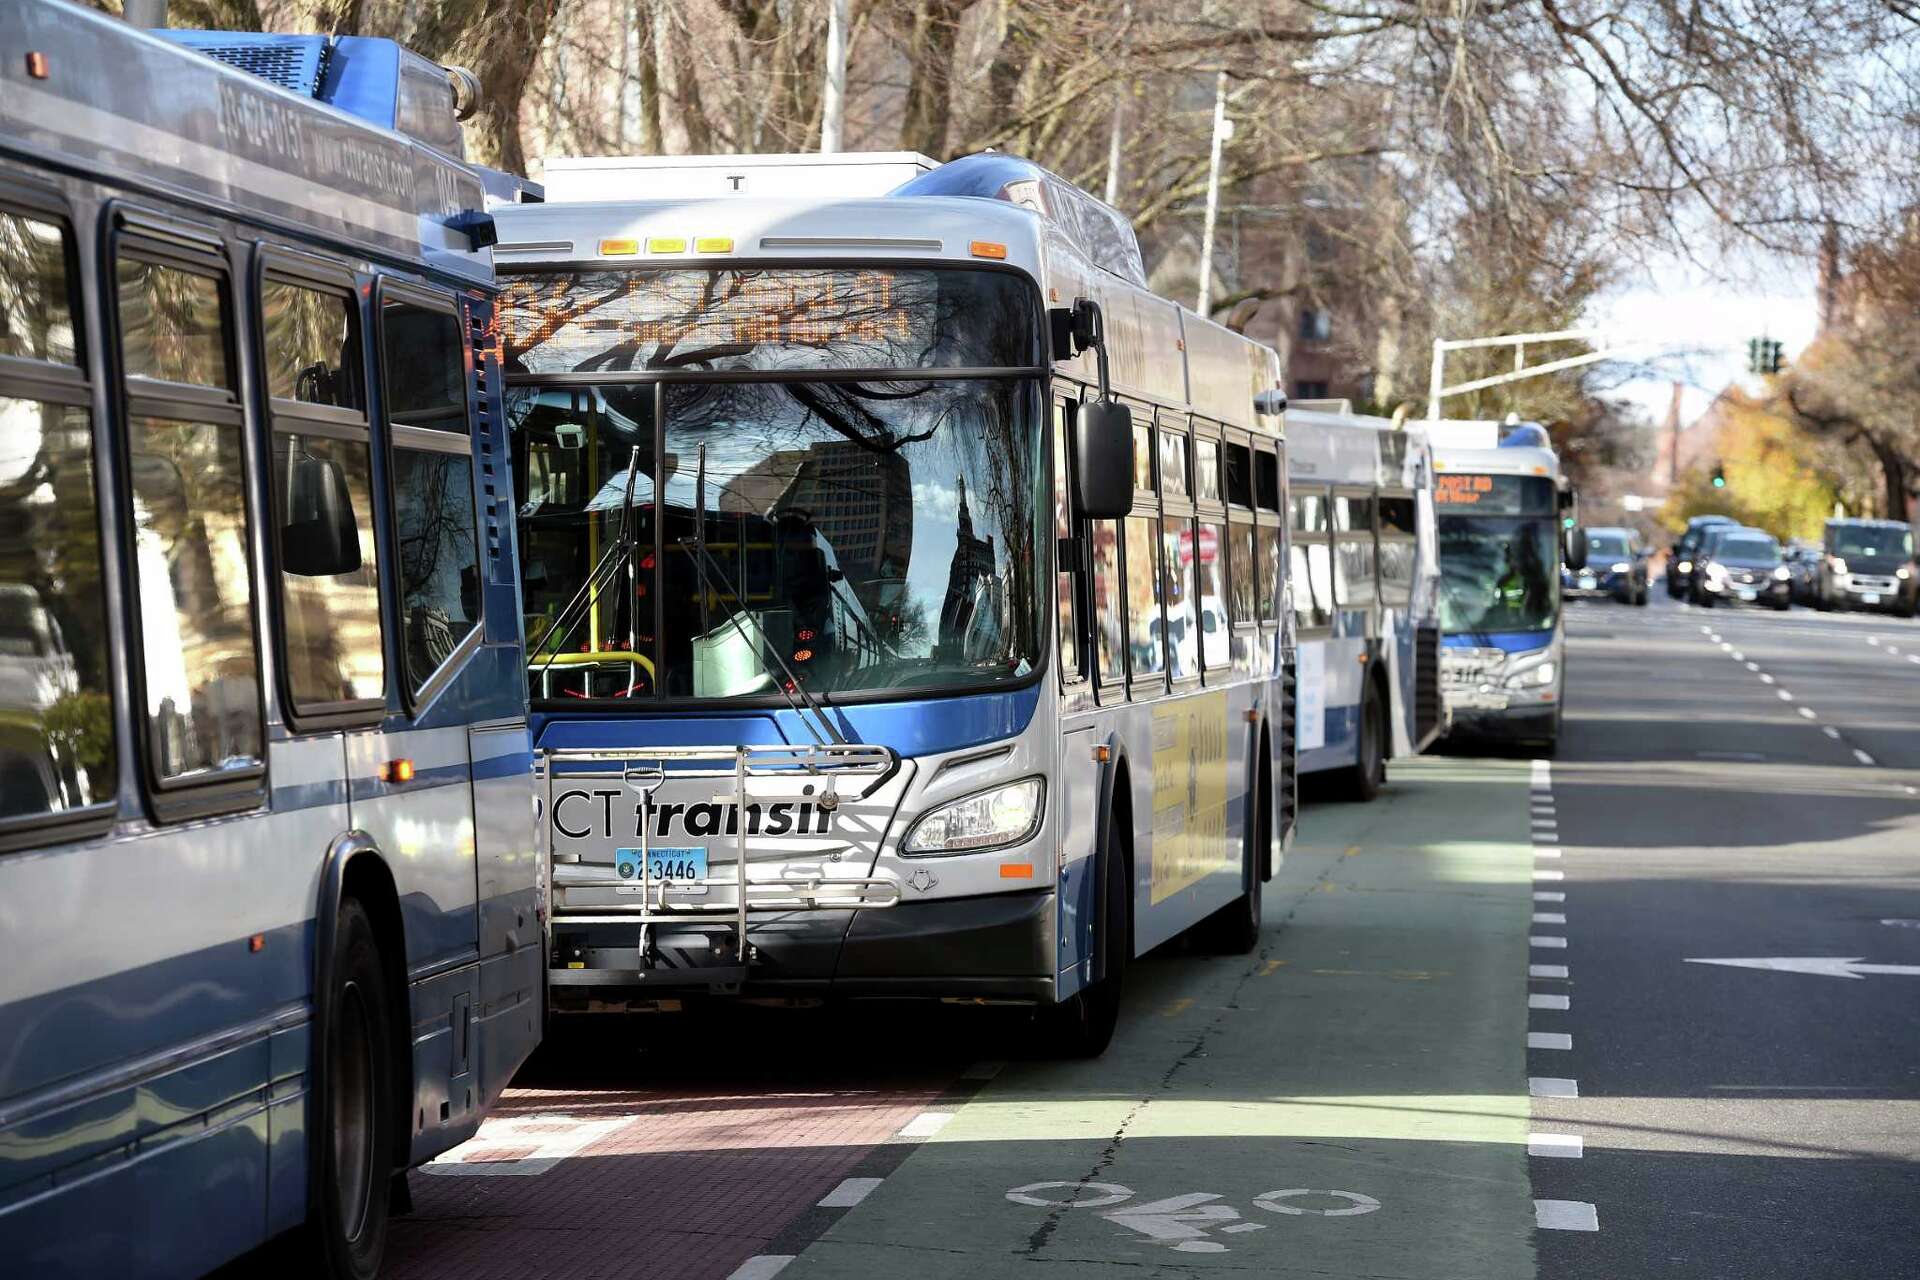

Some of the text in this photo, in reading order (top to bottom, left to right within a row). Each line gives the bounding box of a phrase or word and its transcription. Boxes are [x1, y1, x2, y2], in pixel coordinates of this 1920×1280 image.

[552, 784, 838, 838] CT transit
[637, 850, 685, 858] CNNECTICUT
